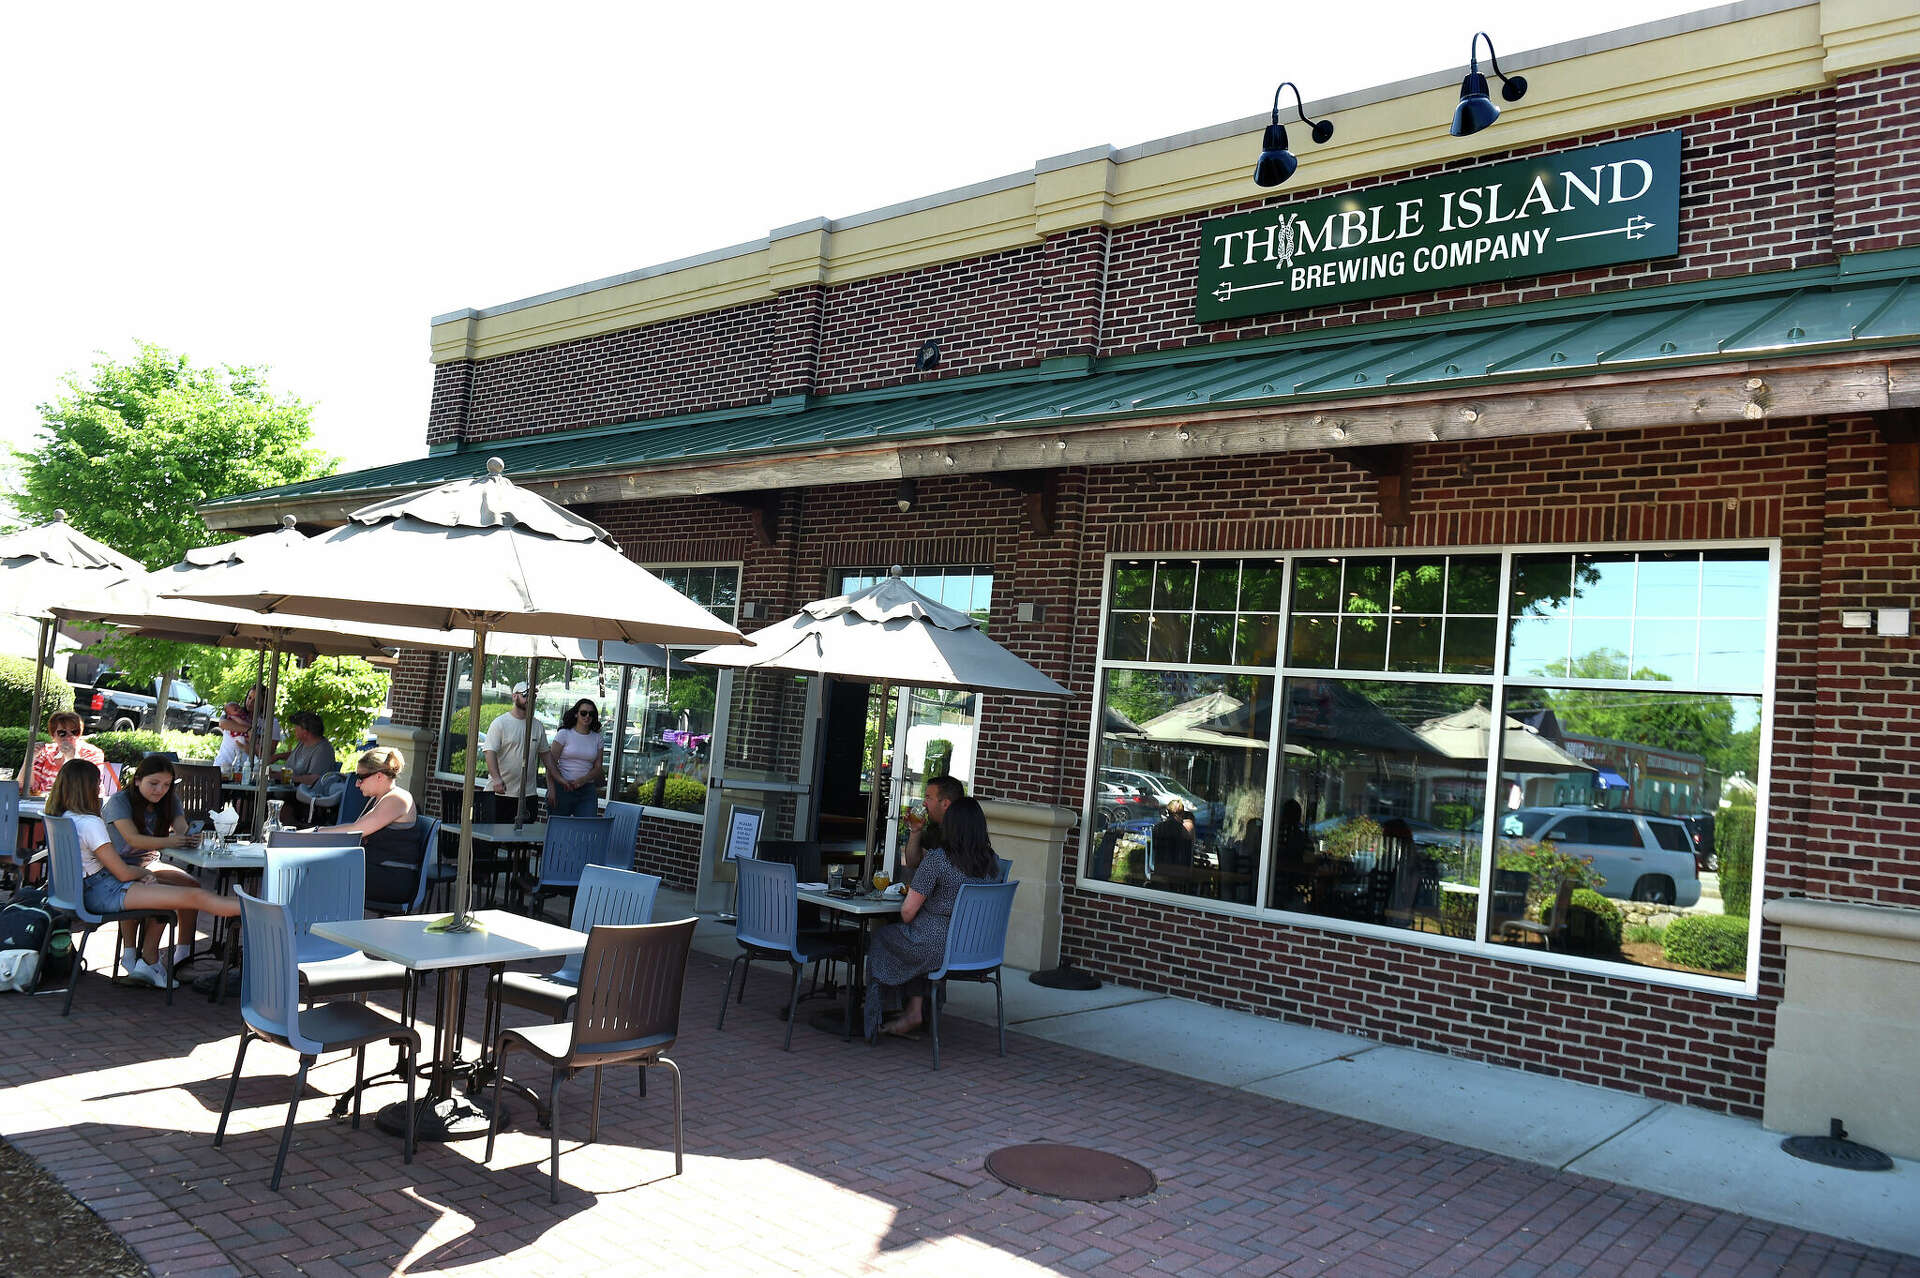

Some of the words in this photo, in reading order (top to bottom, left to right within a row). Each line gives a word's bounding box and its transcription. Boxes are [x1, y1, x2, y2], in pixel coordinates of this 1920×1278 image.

[1438, 158, 1654, 232] ISLAND
[1290, 251, 1405, 292] BREWING
[1413, 227, 1551, 273] COMPANY
